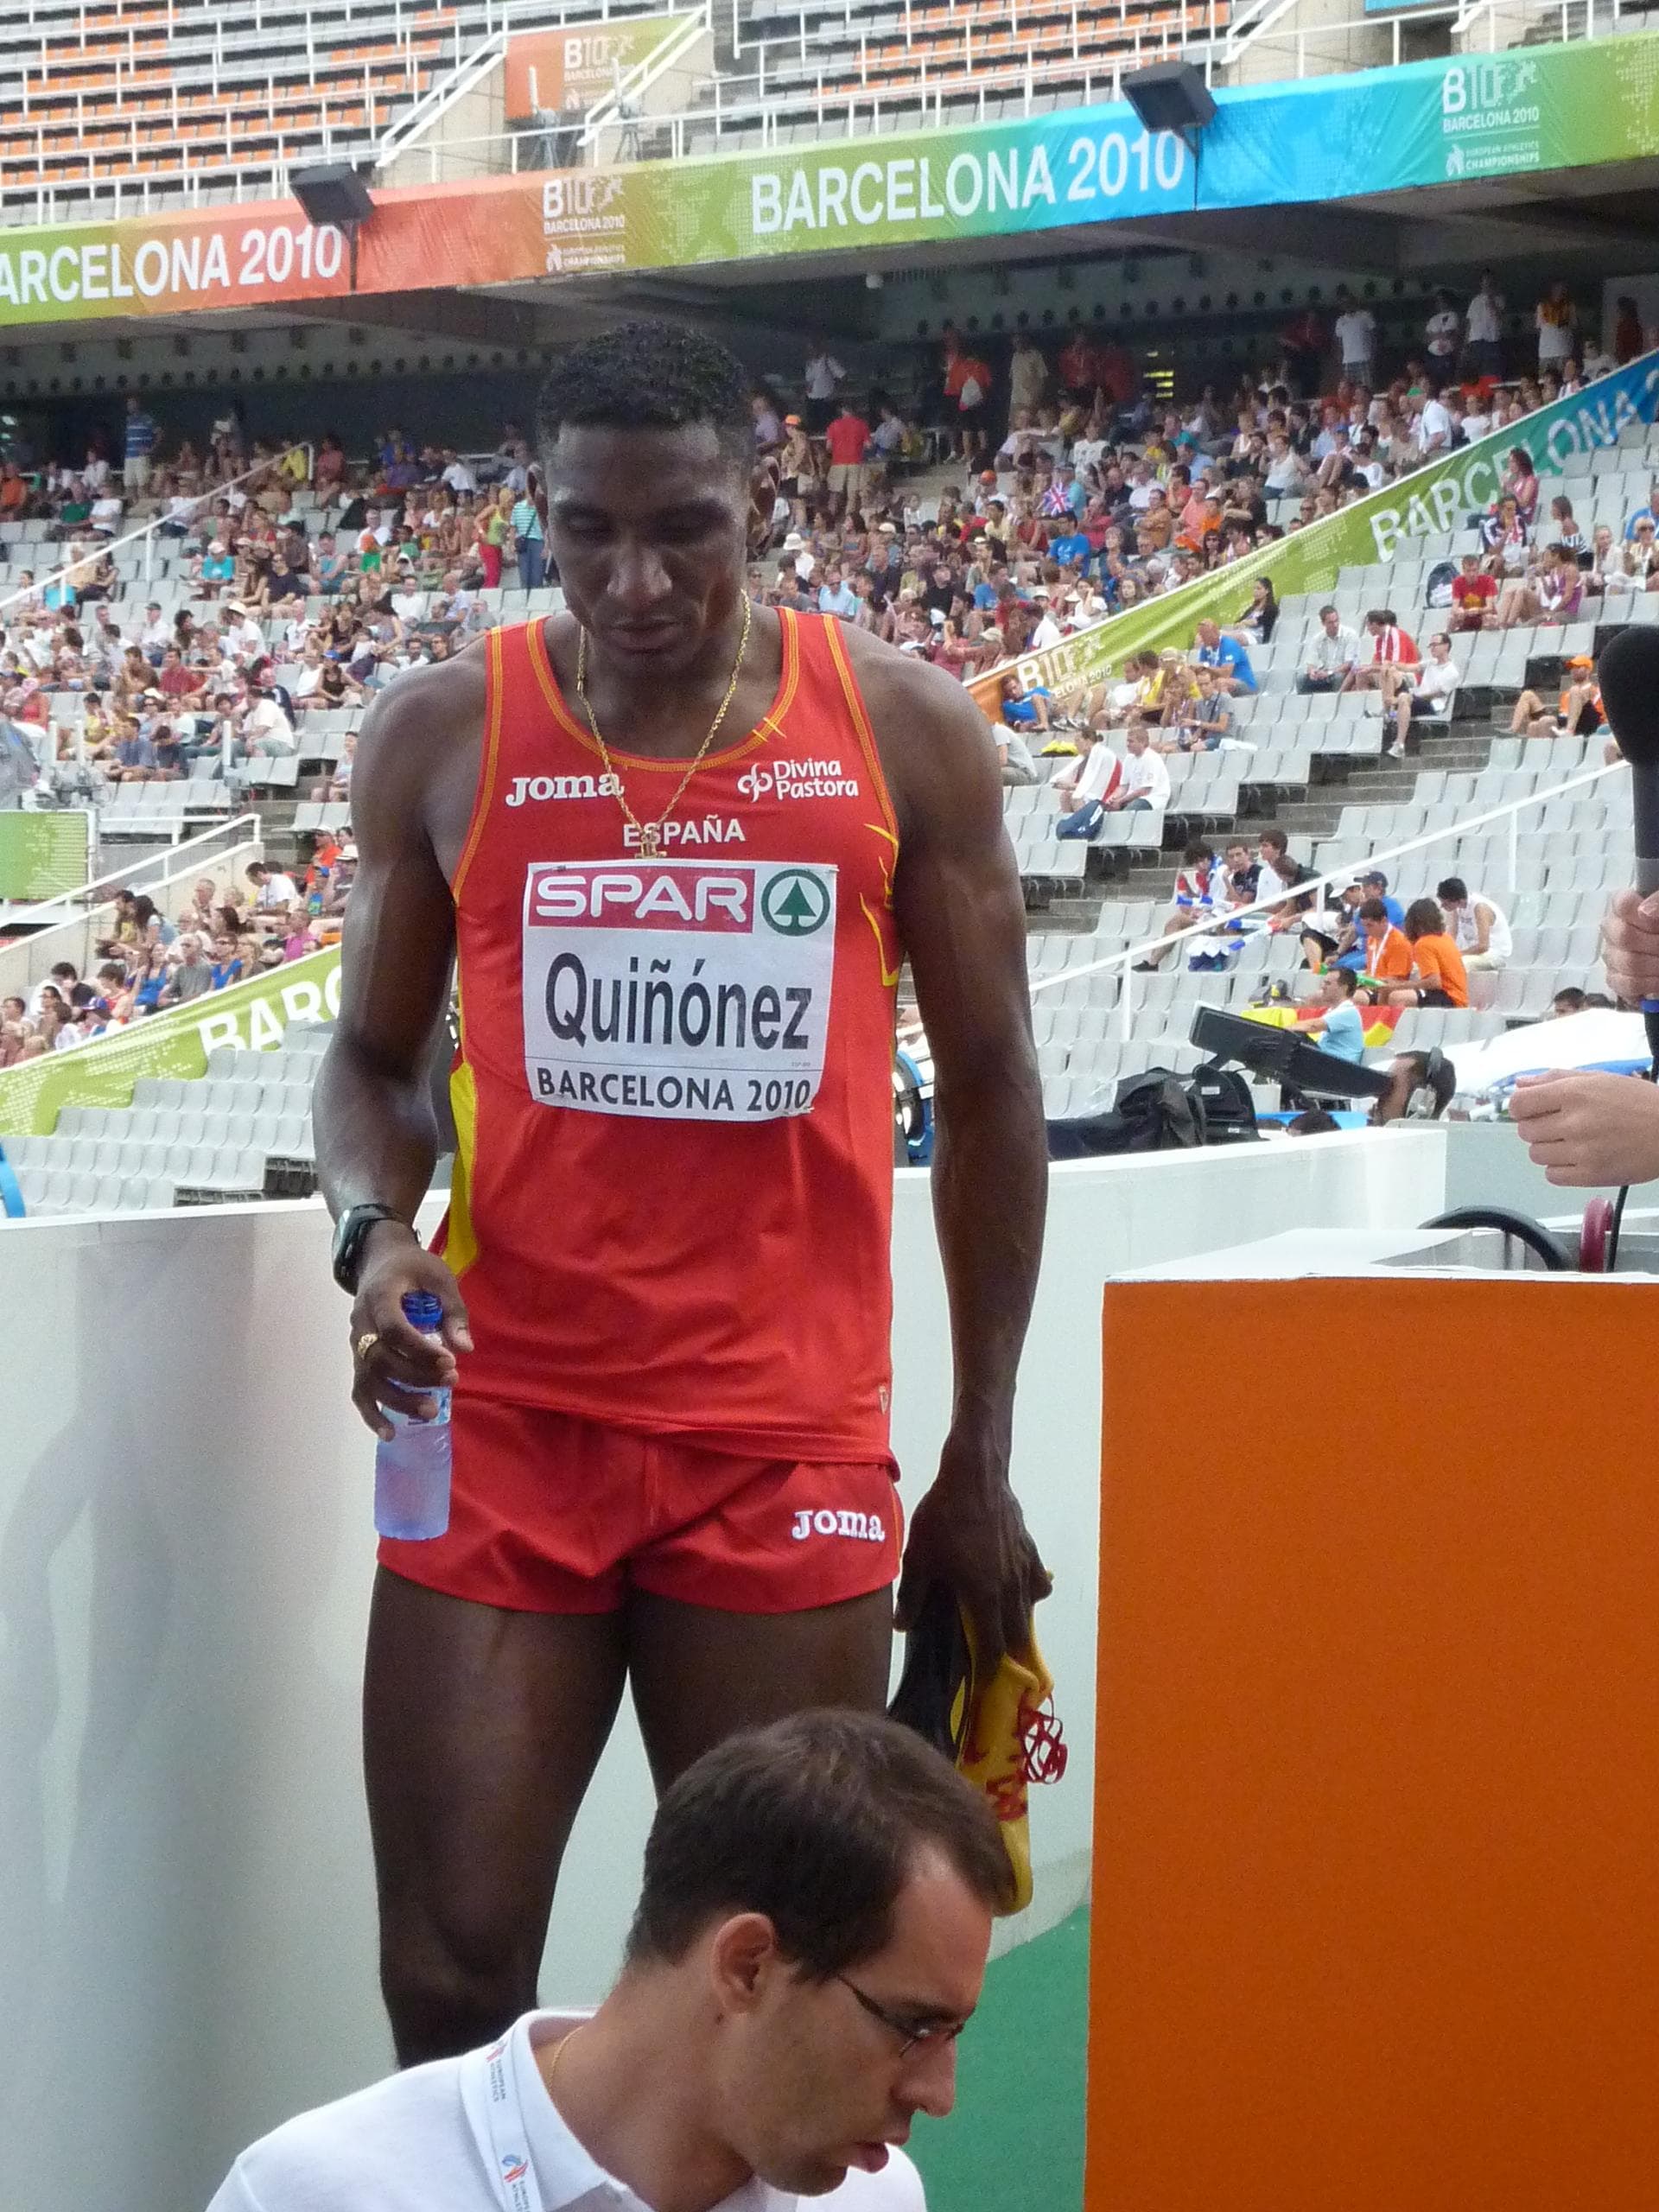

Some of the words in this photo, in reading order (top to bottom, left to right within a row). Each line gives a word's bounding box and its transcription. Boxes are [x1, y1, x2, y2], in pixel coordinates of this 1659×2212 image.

[1443, 109, 1511, 133] BARCELONA
[1512, 105, 1540, 124] 2010
[1465, 151, 1539, 170] CHAMPIONSHIPS
[752, 148, 1058, 236] BARCELONA
[1067, 129, 1185, 202] 2010
[543, 219, 602, 235] BARCELONA
[602, 213, 626, 230] 2010
[0, 234, 230, 305] ARCELONA
[238, 224, 343, 286] 2010
[1089, 664, 1112, 684] 2010
[773, 757, 842, 779] Divina
[776, 776, 859, 801] Pastora
[623, 814, 746, 848] ESPAÑA
[536, 874, 747, 924] SPAR
[545, 952, 813, 1052] Quiñónez
[537, 1067, 734, 1111] BARCELONA
[747, 1079, 811, 1111] 2010
[490, 2063, 499, 2102] ATHLETICS
[496, 2059, 506, 2100] EUROPEAN
